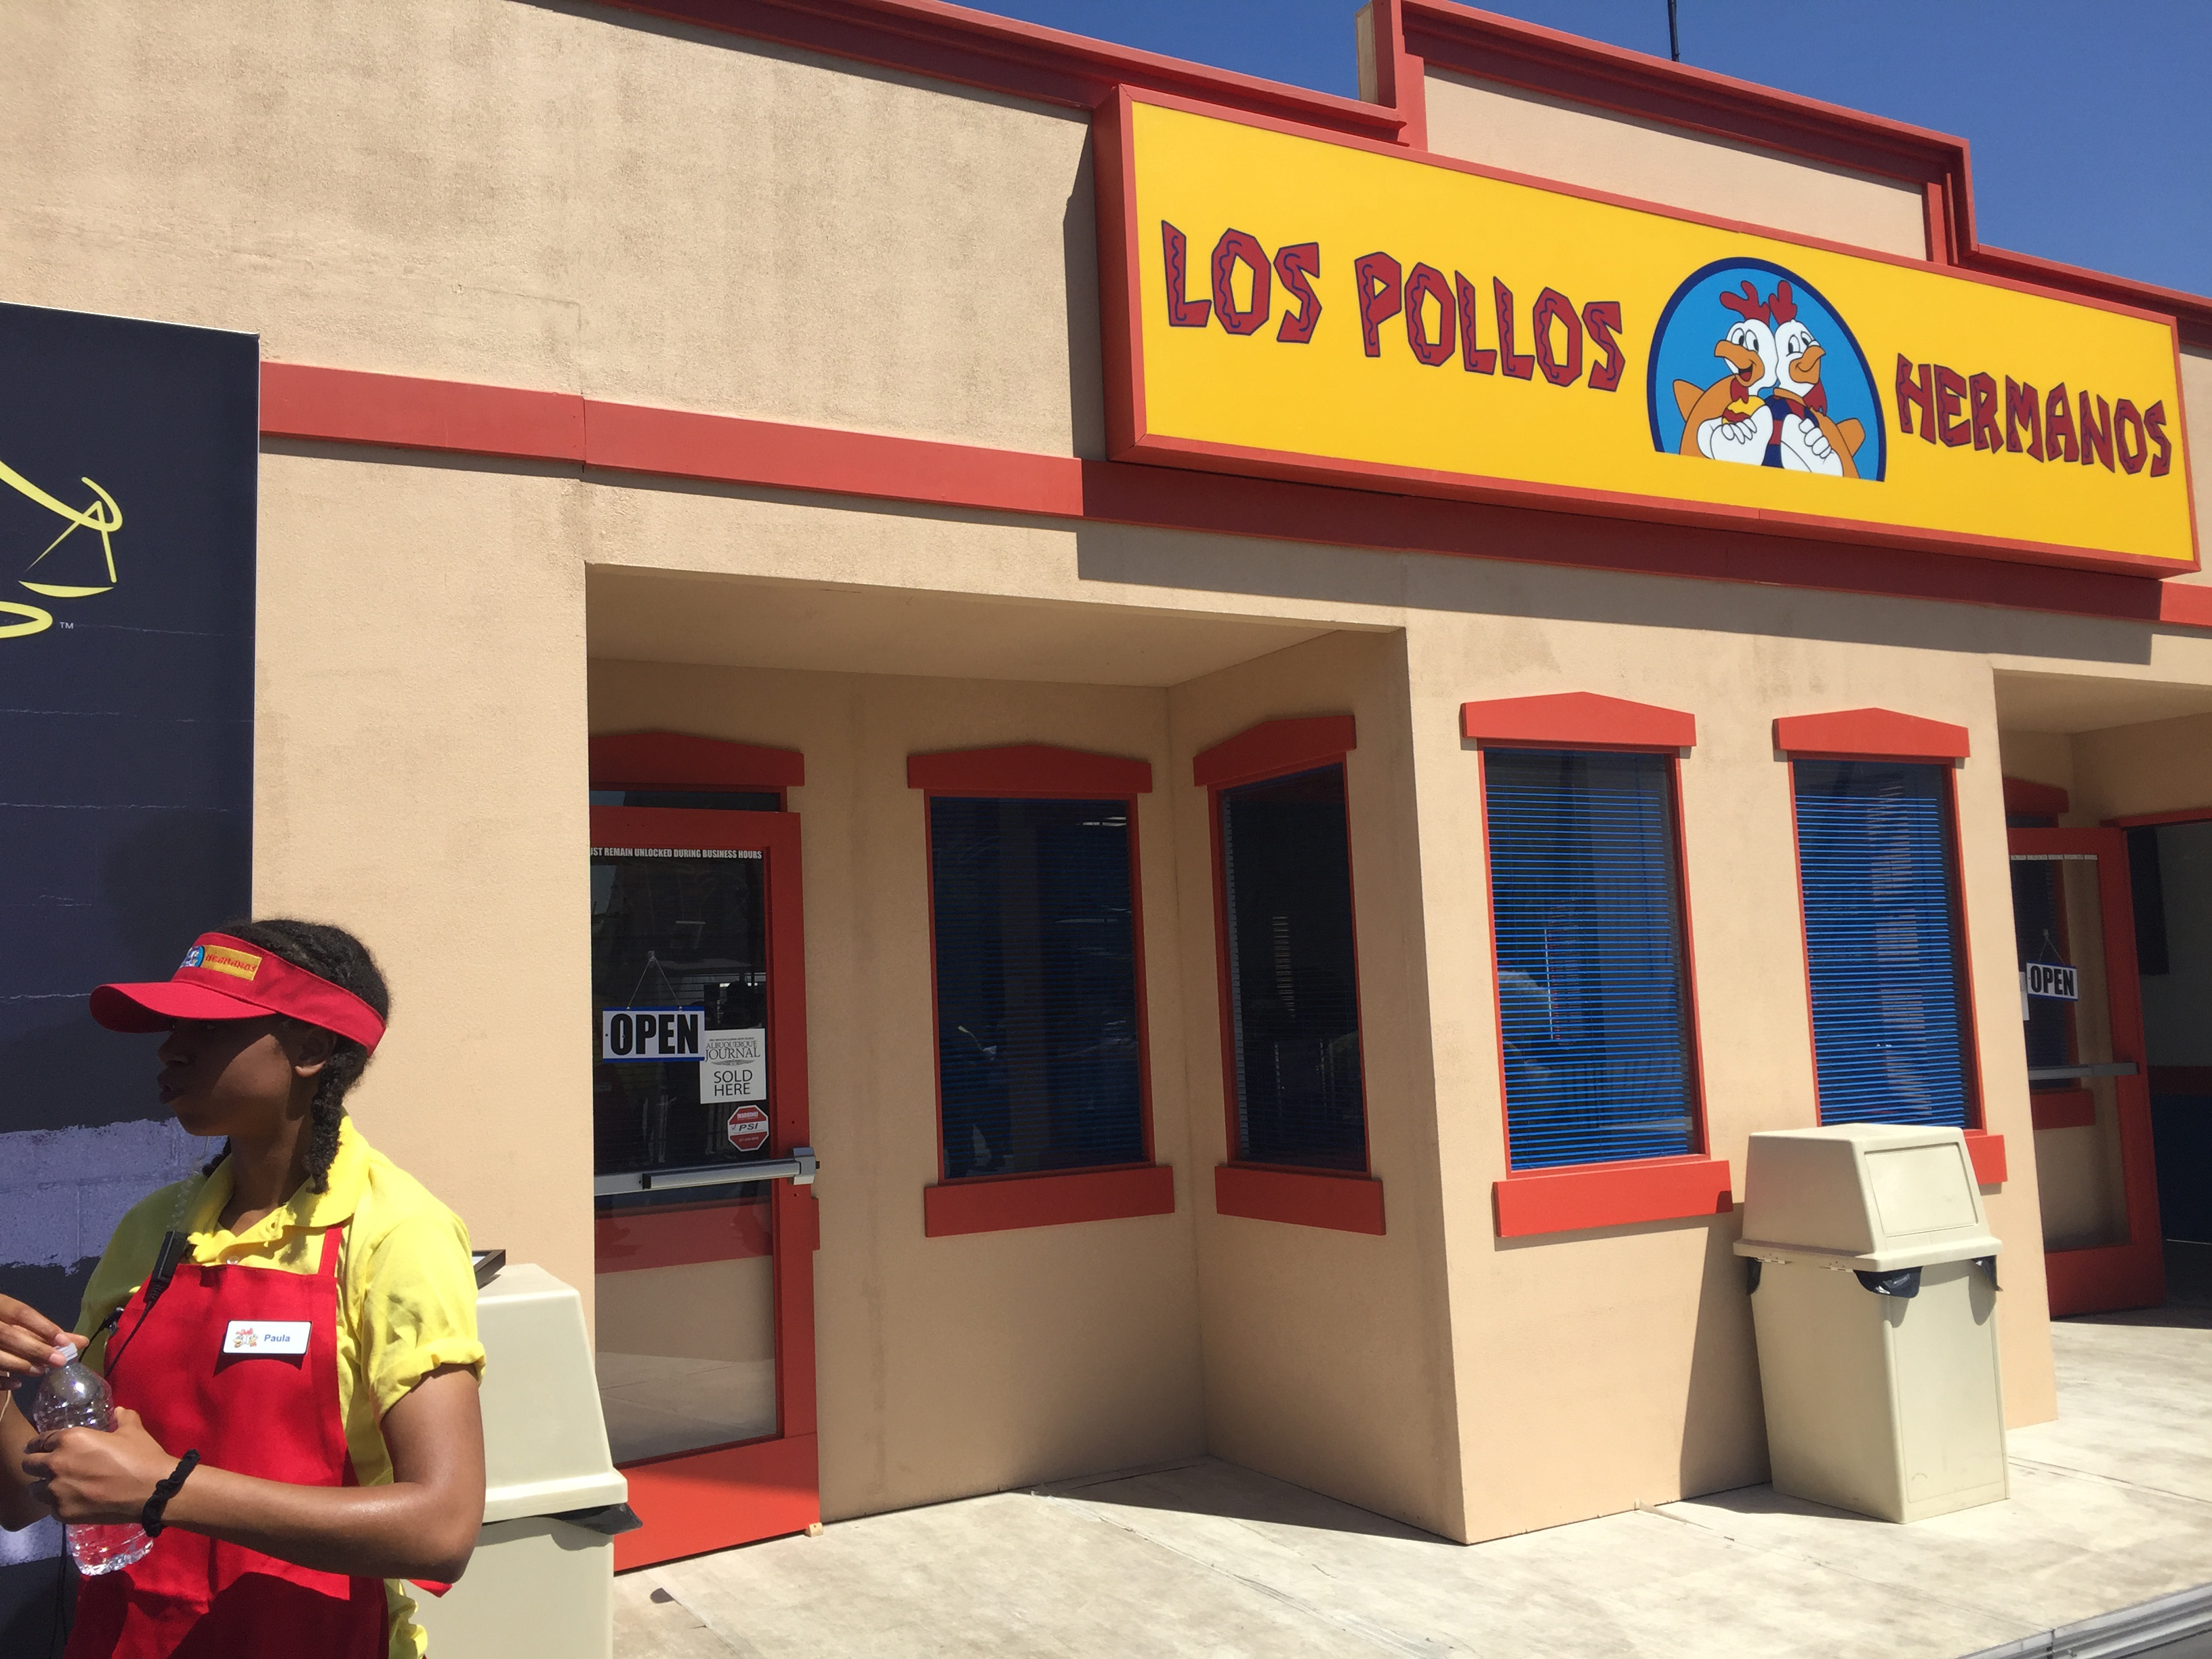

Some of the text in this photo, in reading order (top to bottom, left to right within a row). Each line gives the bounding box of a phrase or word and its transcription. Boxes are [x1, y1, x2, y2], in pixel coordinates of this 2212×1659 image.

[1161, 219, 2171, 478] LOS POLLOS HERMANOS
[604, 847, 633, 857] REMAIN
[634, 848, 672, 857] UNLOCKED
[674, 848, 701, 858] DURING
[702, 849, 737, 859] BUSINESS
[738, 850, 762, 859] HOURS
[2030, 965, 2075, 997] OPEN
[611, 1013, 699, 1056] OPEN
[705, 1040, 757, 1049] ALBUQUERQUE
[705, 1047, 760, 1063] JOURNAL
[714, 1069, 753, 1084] SOLD
[714, 1083, 751, 1097] HERE
[739, 1123, 758, 1132] PSI
[264, 1334, 290, 1342] Paula
